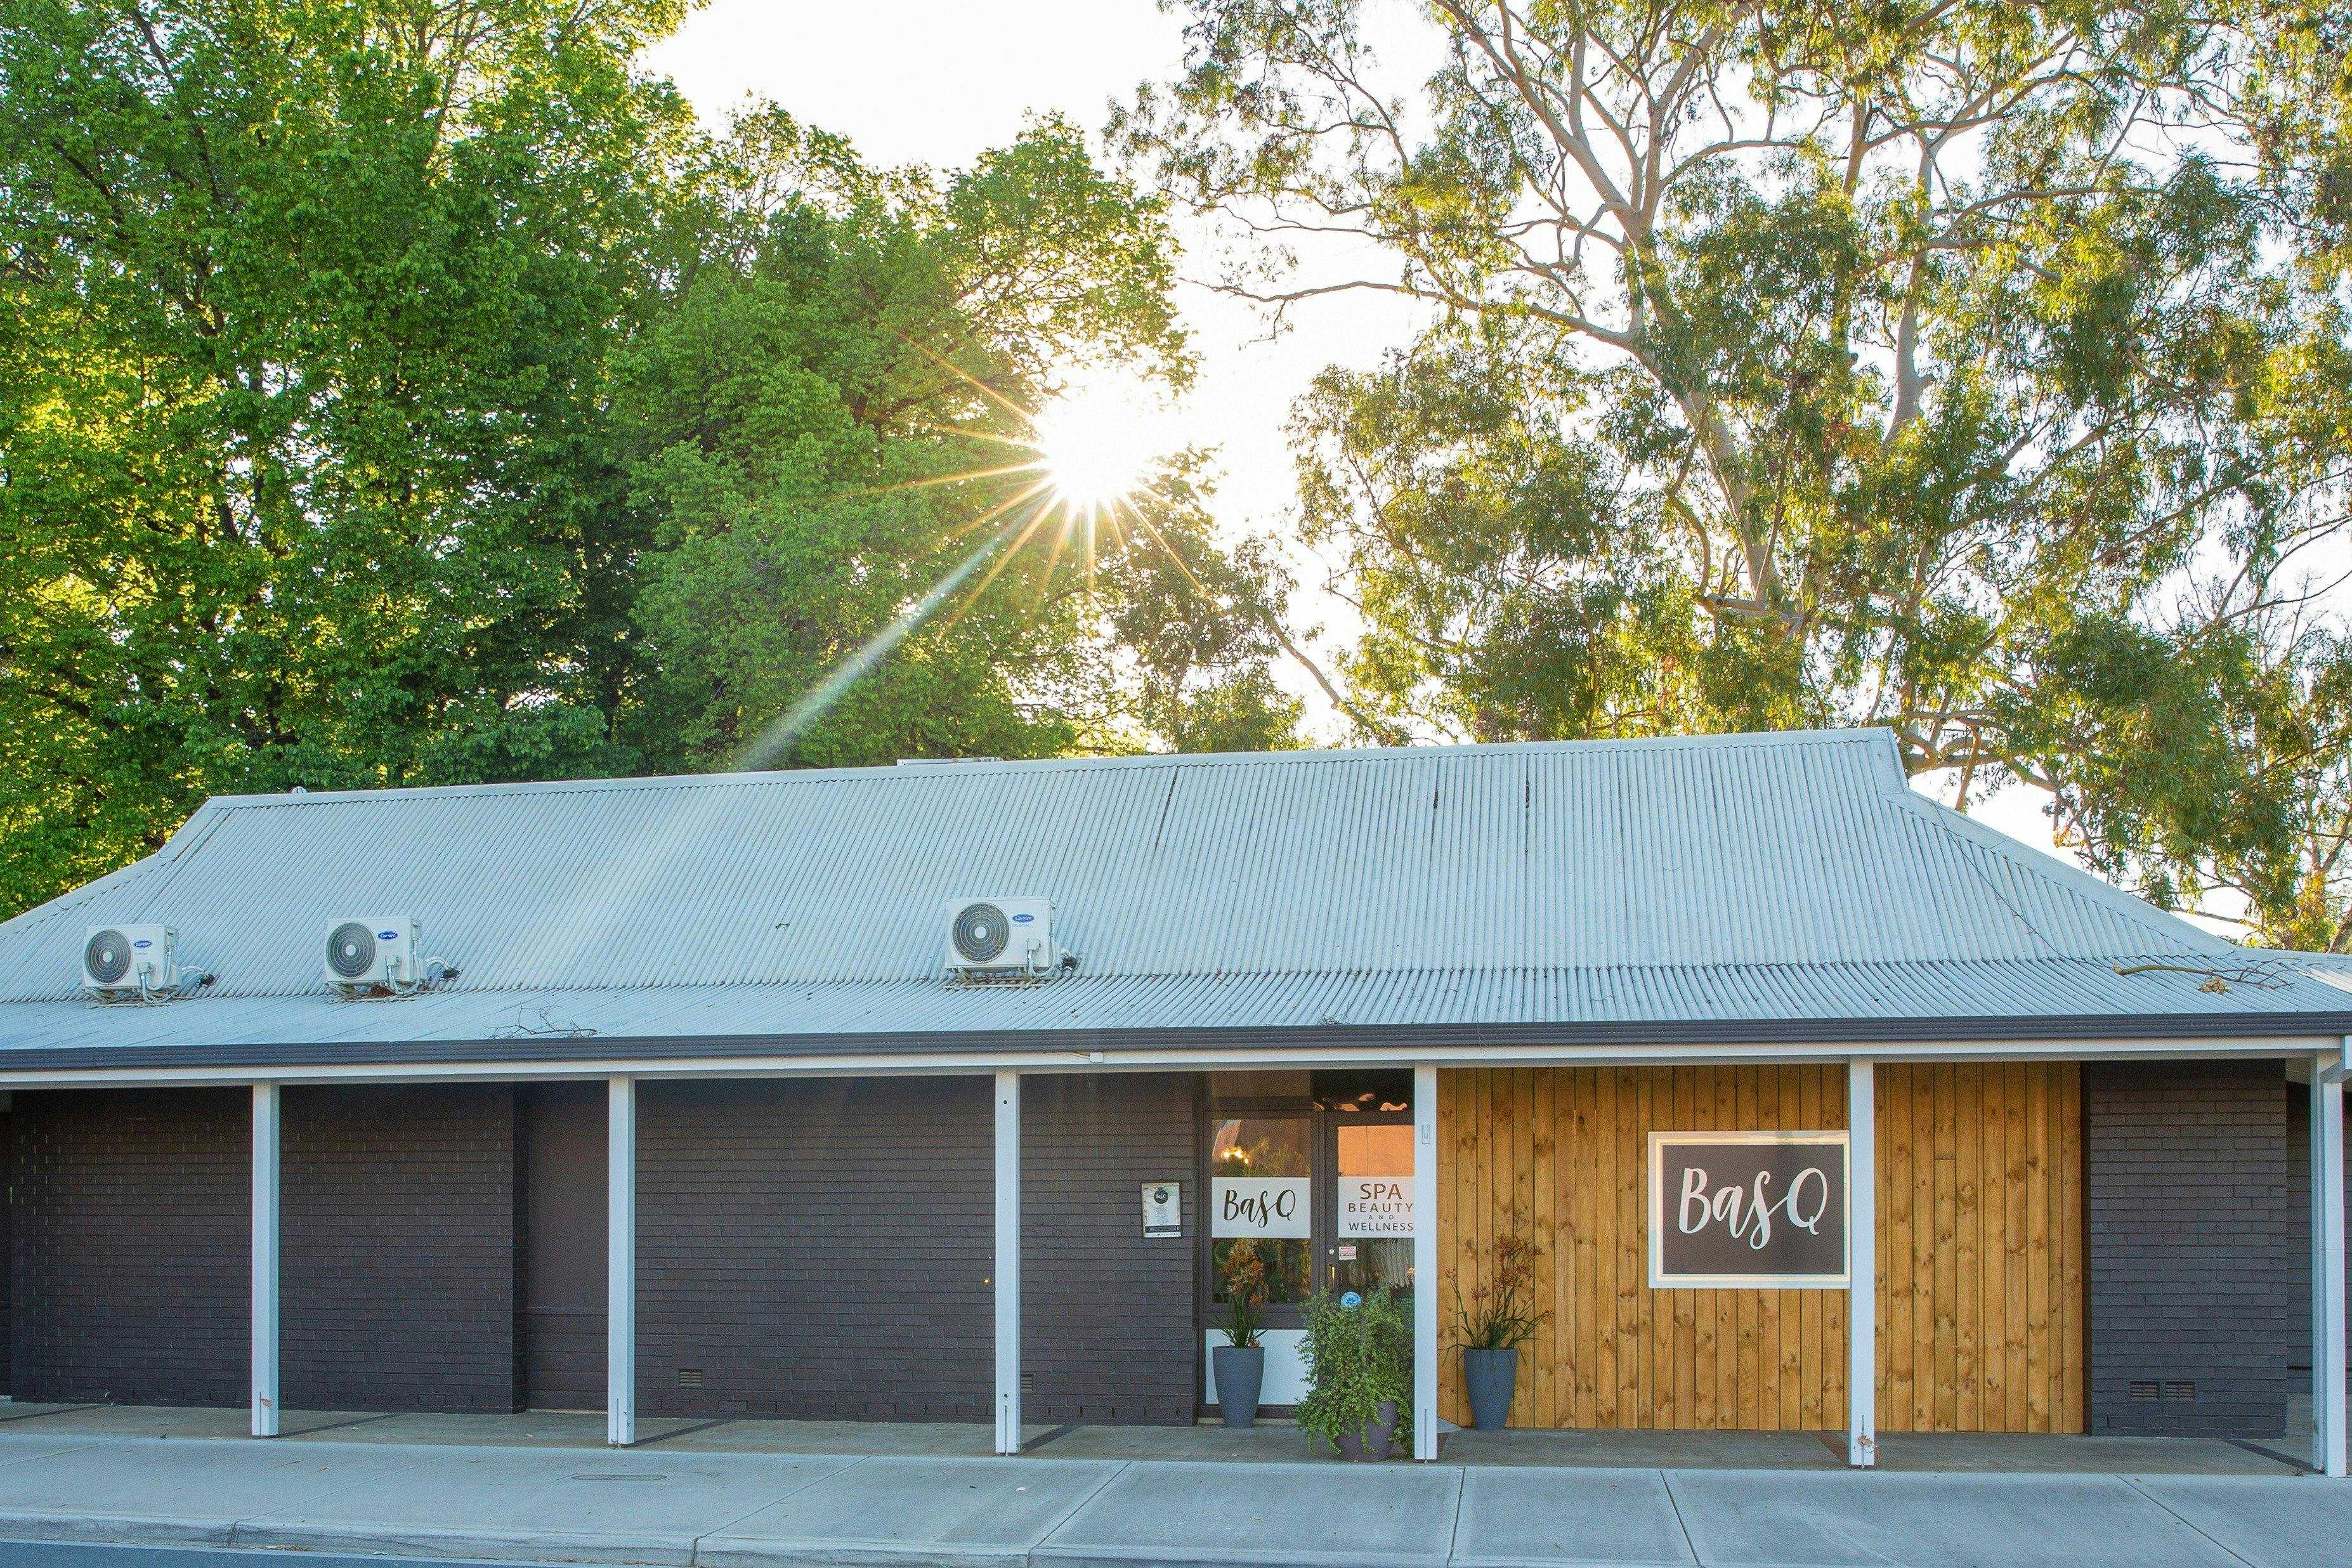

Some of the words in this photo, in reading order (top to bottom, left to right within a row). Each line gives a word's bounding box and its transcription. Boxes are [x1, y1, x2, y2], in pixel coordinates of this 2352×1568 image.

[1360, 1183, 1402, 1199] SPA
[1223, 1189, 1296, 1228] BasQ
[1349, 1203, 1413, 1213] BEAUTY
[1678, 1168, 1828, 1250] BasQ
